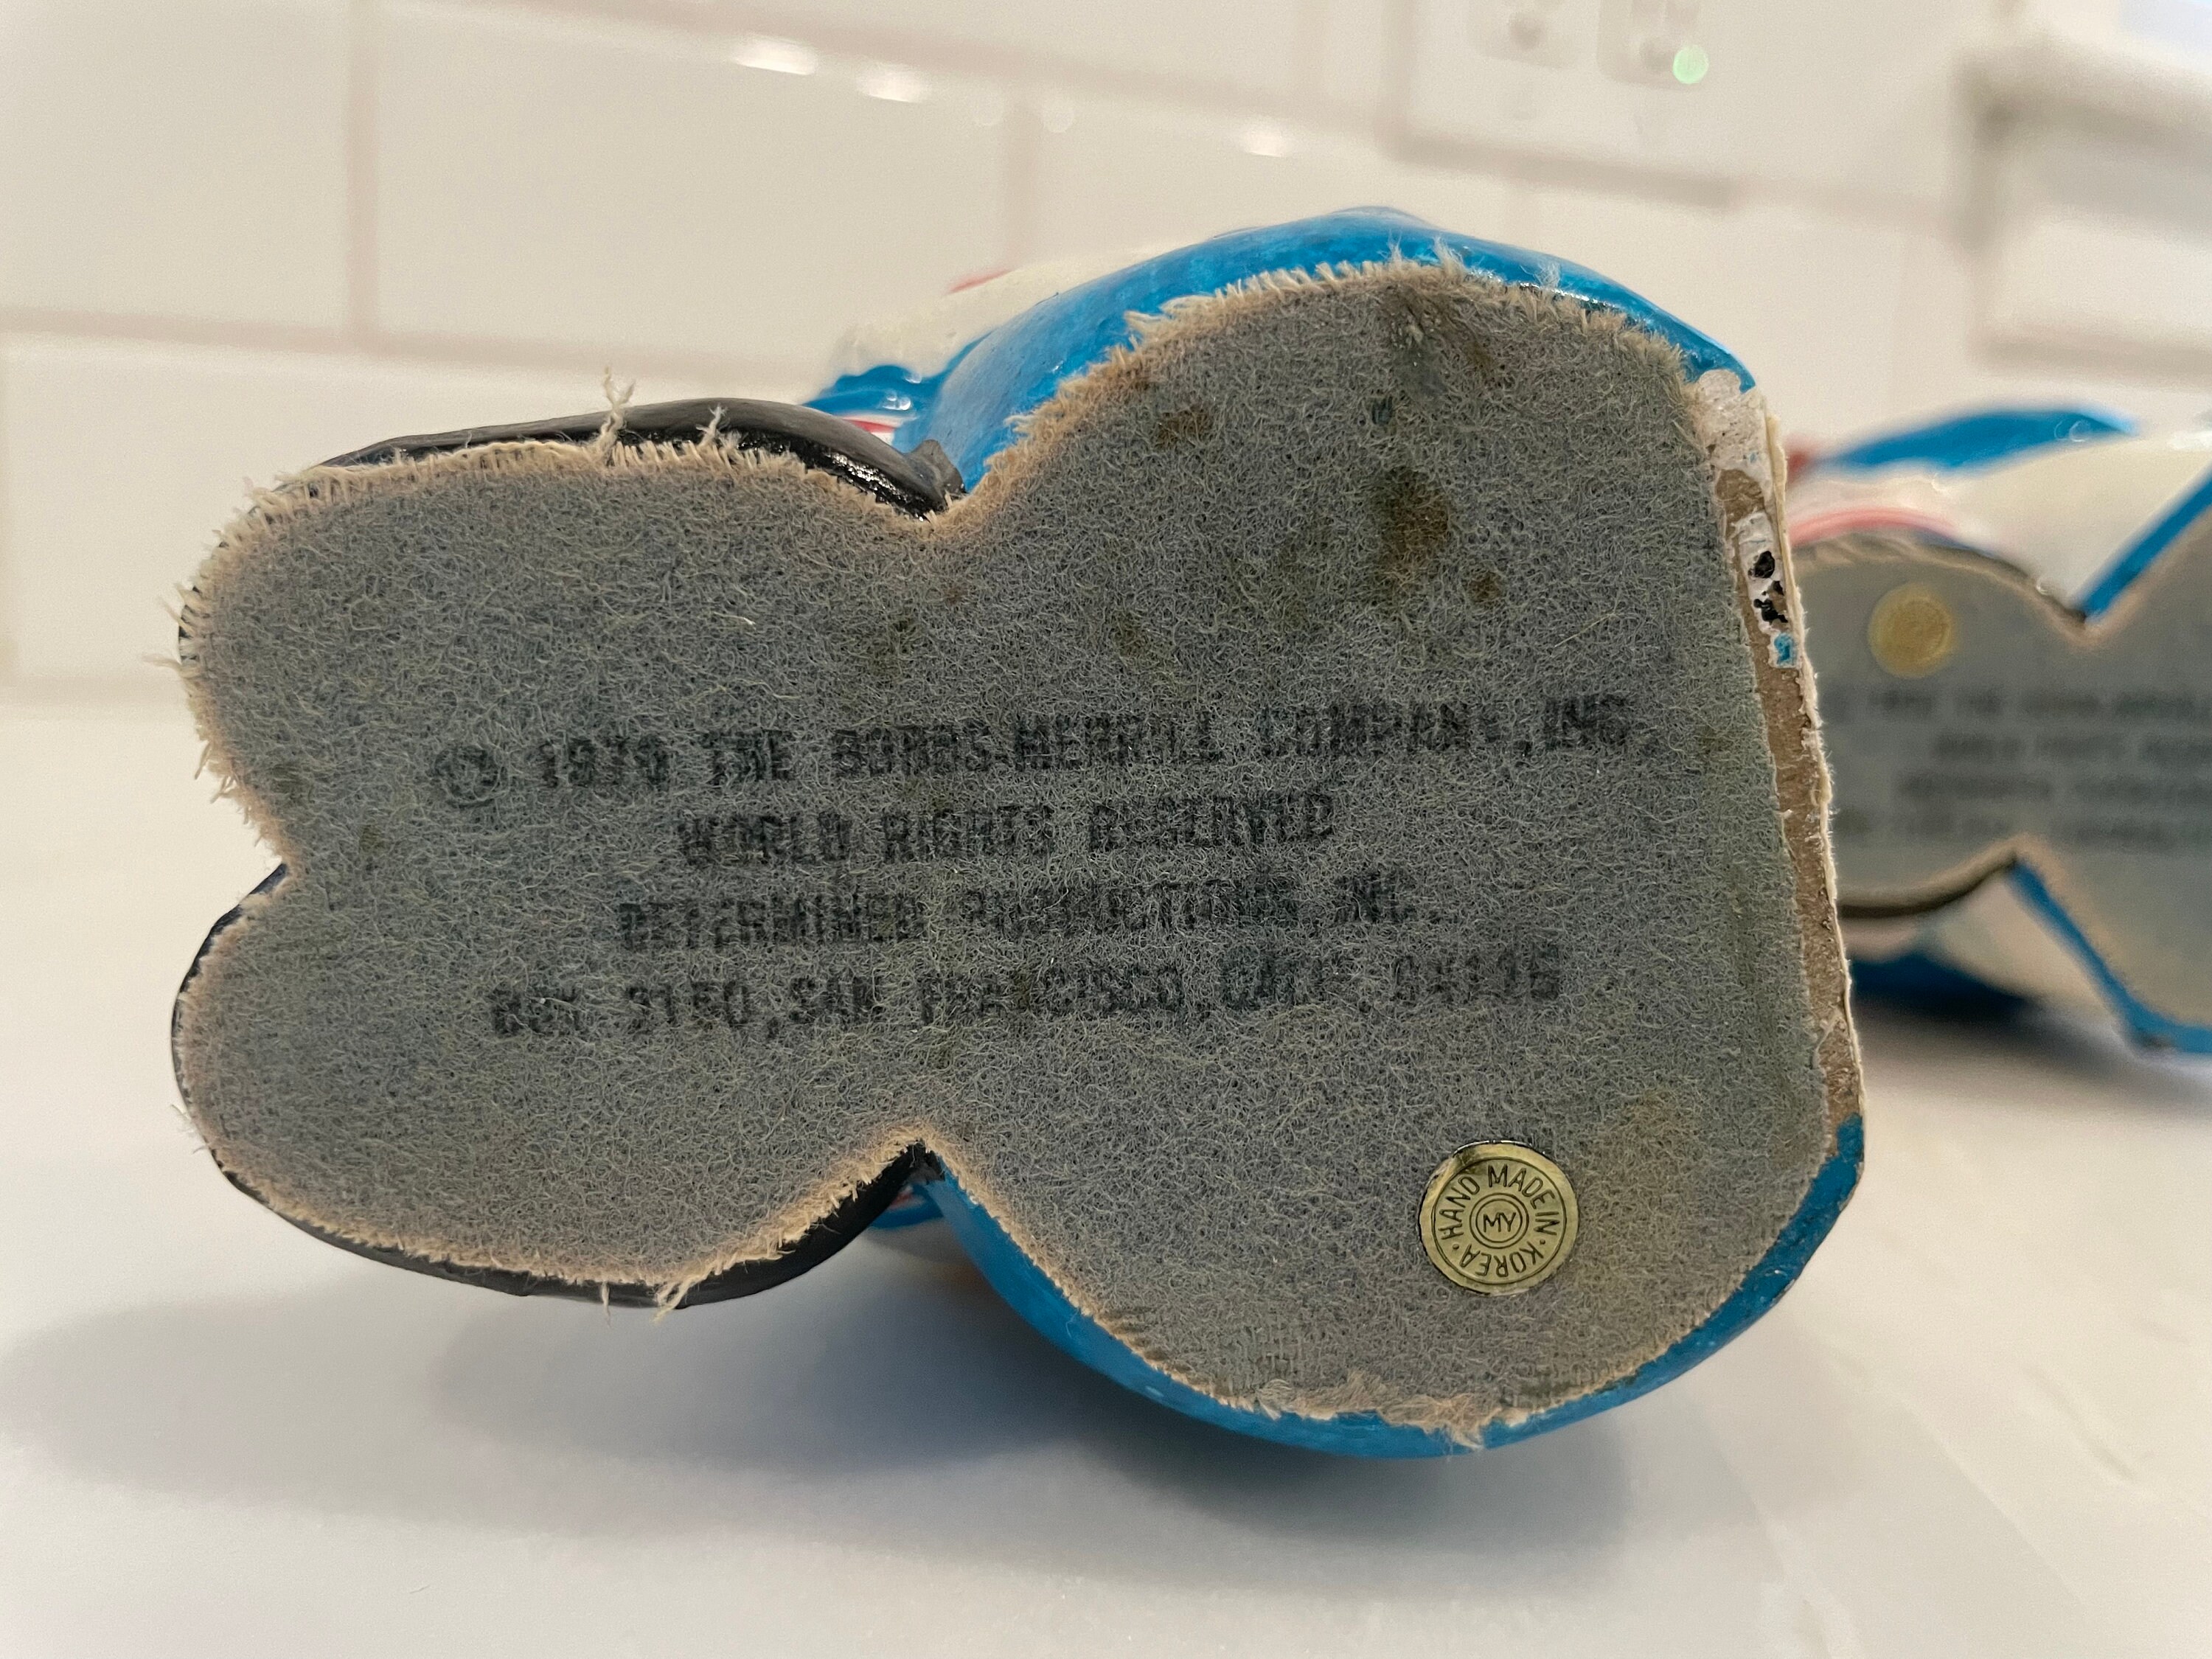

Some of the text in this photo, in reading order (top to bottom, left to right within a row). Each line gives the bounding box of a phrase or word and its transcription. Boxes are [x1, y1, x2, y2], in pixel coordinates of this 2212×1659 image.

[699, 728, 794, 789] THE
[678, 791, 1333, 869] WORLD RIGHTS RESERVED
[619, 888, 926, 951] DETERMINED
[789, 973, 883, 1026] SAN
[1439, 1163, 1559, 1278] HAND MADE IN KOREA
